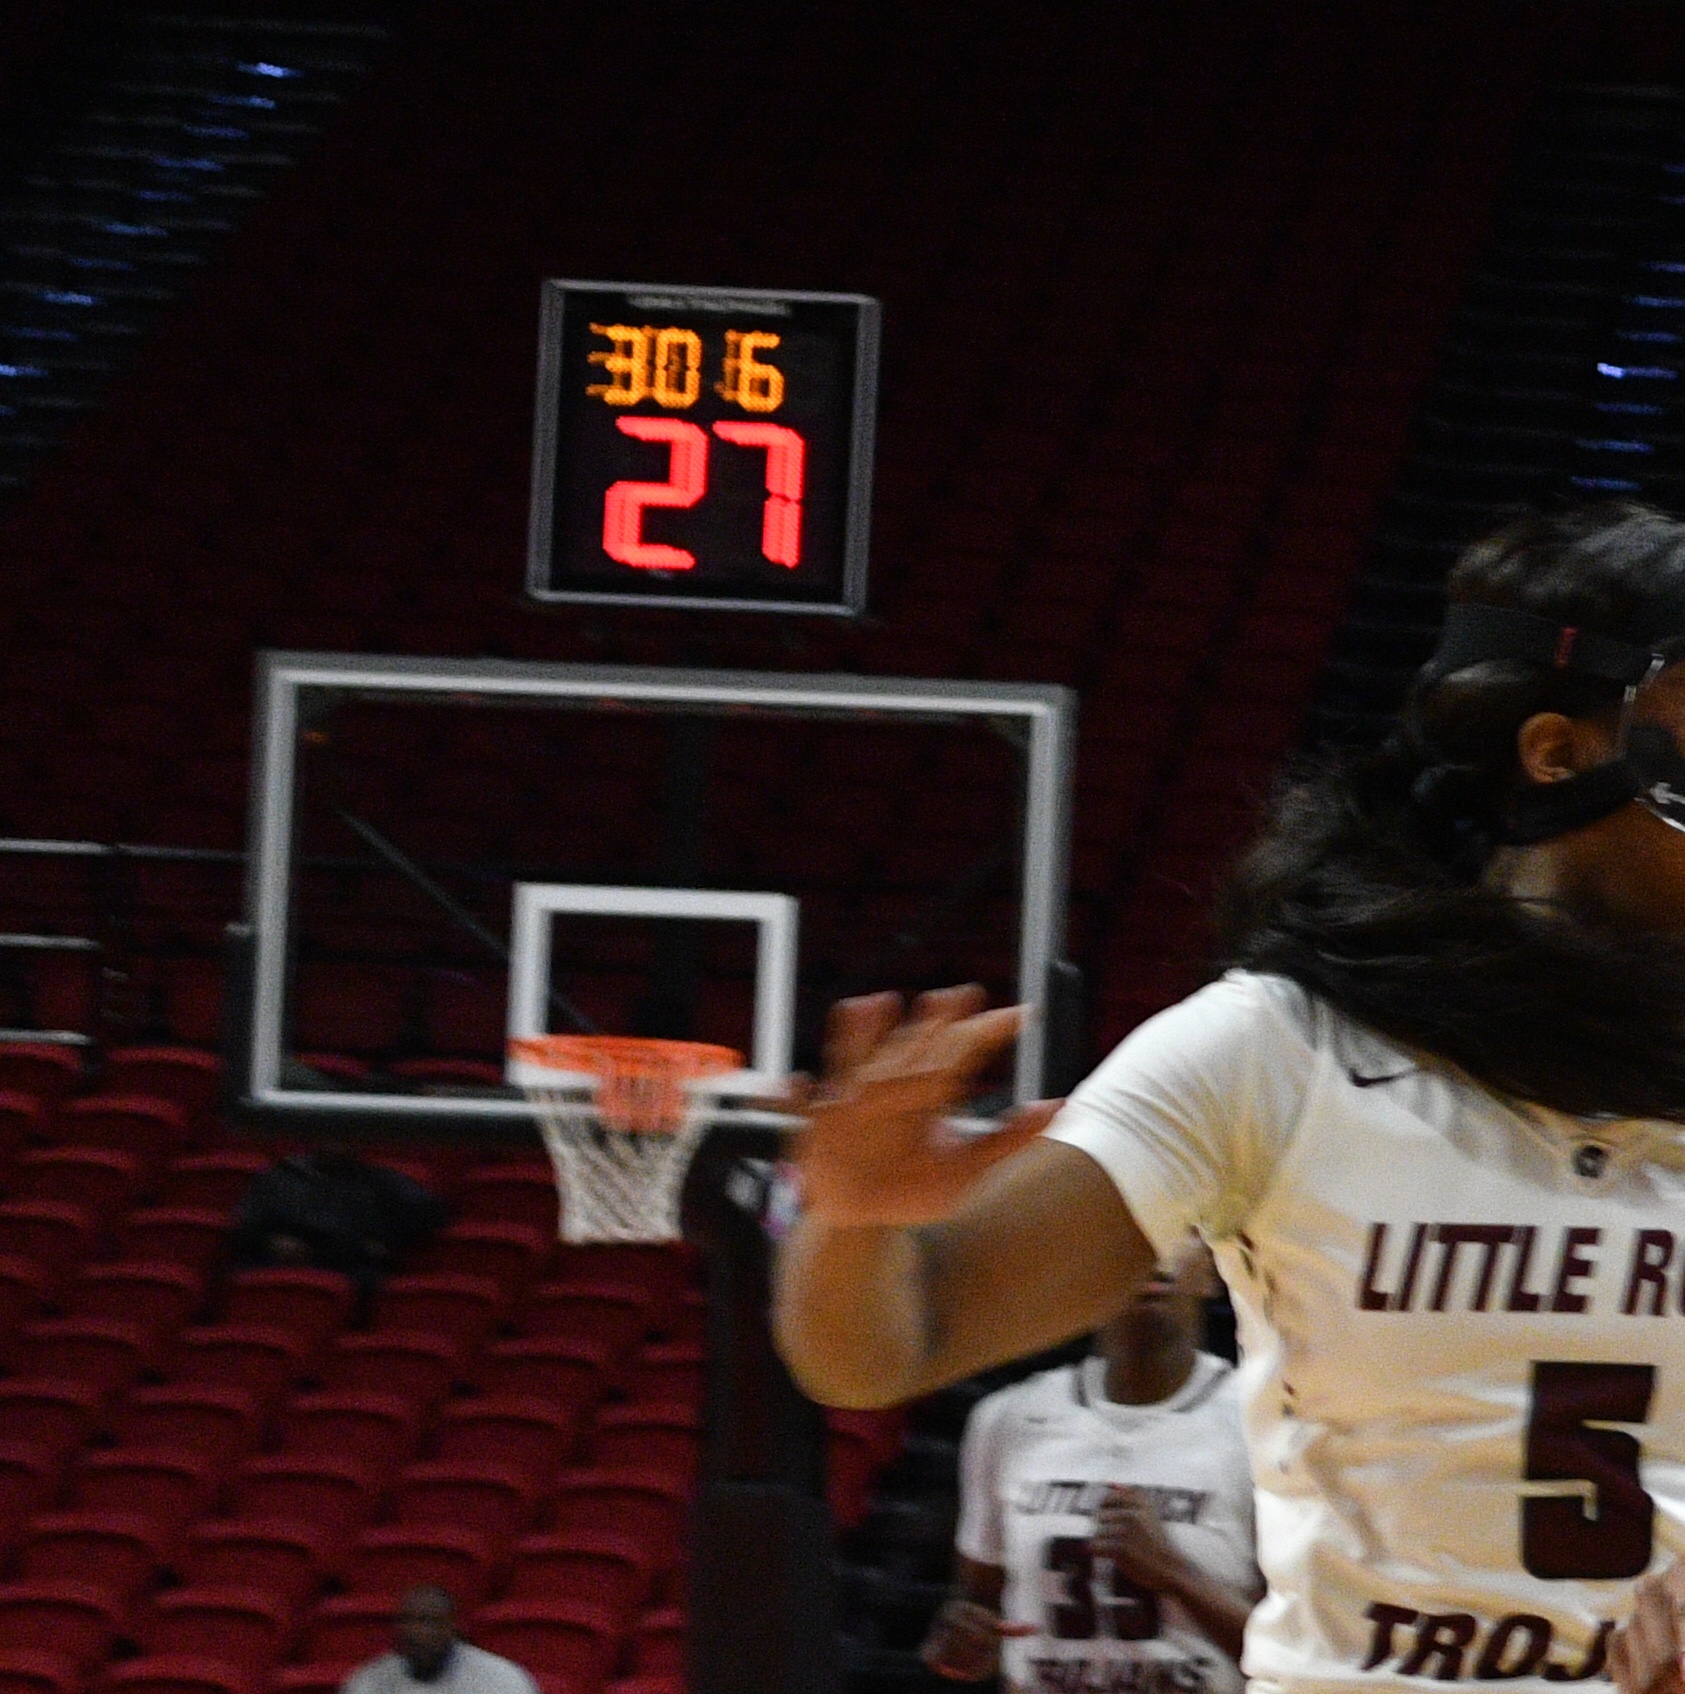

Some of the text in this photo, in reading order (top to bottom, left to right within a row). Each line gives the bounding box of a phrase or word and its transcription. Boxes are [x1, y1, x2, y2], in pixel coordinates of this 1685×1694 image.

[602, 415, 806, 570] 27
[1358, 1222, 1604, 1313] LITTLE
[1521, 1361, 1655, 1580] 5
